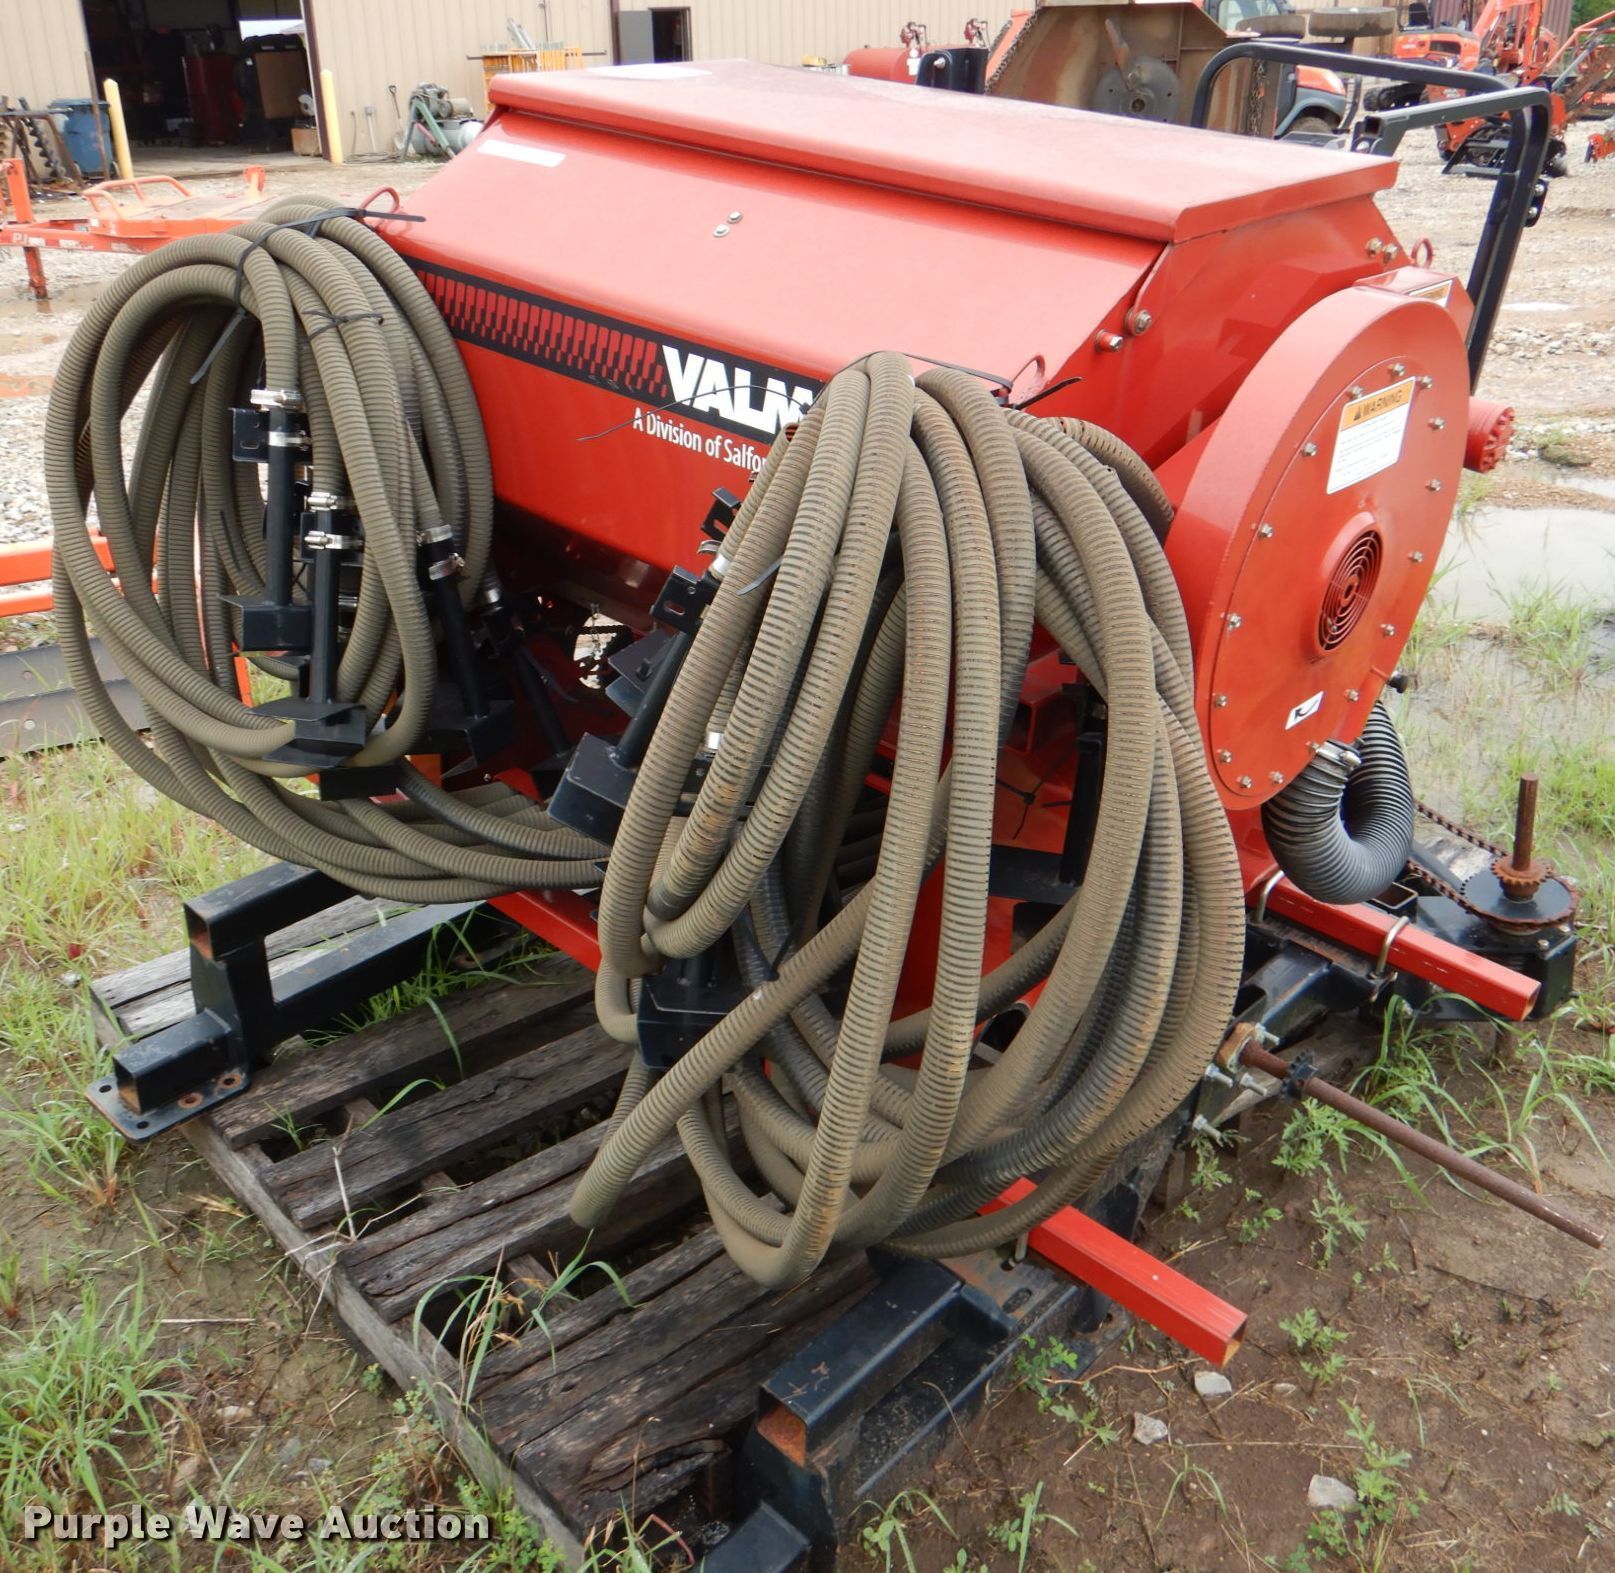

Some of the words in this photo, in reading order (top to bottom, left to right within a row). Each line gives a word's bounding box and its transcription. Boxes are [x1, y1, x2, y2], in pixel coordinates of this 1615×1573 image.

[633, 407, 644, 432] A
[646, 411, 702, 453] Division
[705, 434, 723, 458] of
